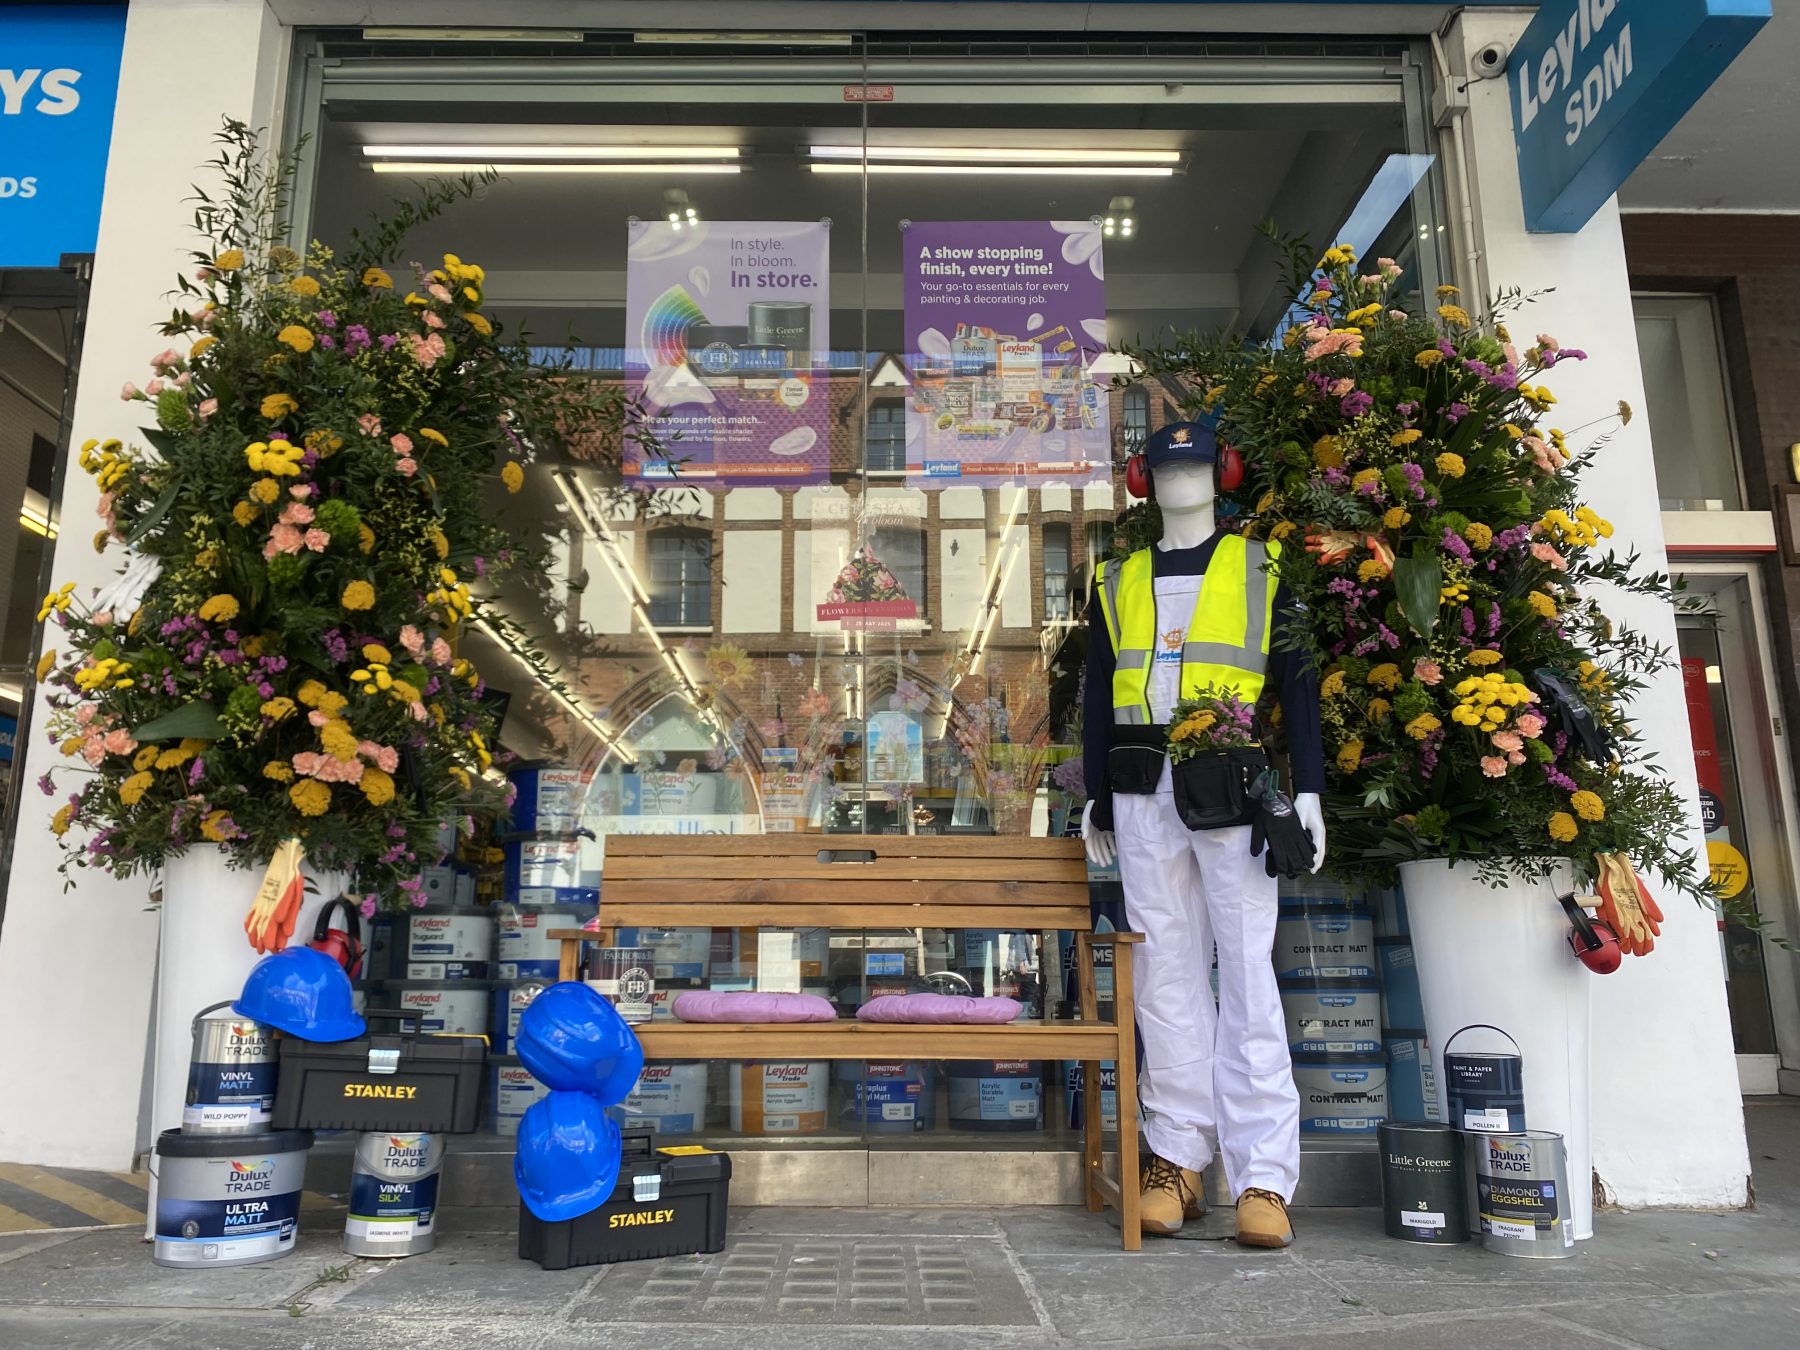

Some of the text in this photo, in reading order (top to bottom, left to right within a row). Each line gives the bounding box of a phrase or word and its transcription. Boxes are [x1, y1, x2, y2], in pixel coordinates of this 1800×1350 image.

[1519, 0, 1620, 133] Leyla
[1565, 21, 1633, 147] SDM
[731, 238, 785, 252] In style.
[919, 246, 1044, 261] A show stopping
[731, 255, 797, 267] In bloom.
[920, 262, 1053, 277] finish, every time!
[731, 270, 818, 288] In store.
[921, 281, 1069, 293] Your go-to essentials for every
[920, 295, 1047, 304] painting & decorating job.
[776, 326, 805, 335] Greene
[1002, 344, 1035, 354] Leyland
[668, 416, 690, 426] your
[691, 415, 726, 426] perfect
[926, 463, 959, 474] Leyland
[828, 502, 906, 516] CHSEA
[542, 772, 579, 784] Leyland
[763, 775, 804, 785] Leyand
[413, 918, 452, 930] Leyland
[412, 933, 444, 941] Truguard
[1293, 945, 1368, 954] CONTRACT MATT
[404, 993, 442, 1004] Leyland
[1298, 1019, 1374, 1028] CORACT MATT
[230, 1034, 267, 1046] Dulux
[225, 1046, 269, 1056] TRADE
[220, 1071, 254, 1081] VINYL
[639, 1065, 673, 1080] yland
[765, 1064, 809, 1078] Leyland
[1424, 1072, 1434, 1080] Su
[219, 1081, 252, 1089] MATT
[344, 1084, 417, 1098] STANLEY
[856, 1092, 891, 1101] Viyl Matt
[1309, 1094, 1384, 1104] CONTRACT MATT
[388, 1146, 423, 1157] Dulux
[1490, 1149, 1527, 1161] Dulux
[384, 1158, 426, 1168] TRADE
[1389, 1153, 1451, 1167] Little Greene
[1489, 1159, 1531, 1172] TRADE
[229, 1170, 269, 1182] Dulux
[225, 1180, 271, 1193] TRADE
[380, 1184, 412, 1193] VINYL
[1490, 1185, 1540, 1197] DIAMOND
[378, 1194, 401, 1203] SILK
[1491, 1194, 1544, 1206] EGGSHELL
[226, 1201, 269, 1215] ULTRA
[224, 1212, 264, 1226] MATT
[609, 1209, 674, 1228] STANLEY
[1499, 1225, 1525, 1233] FRAGRANT
